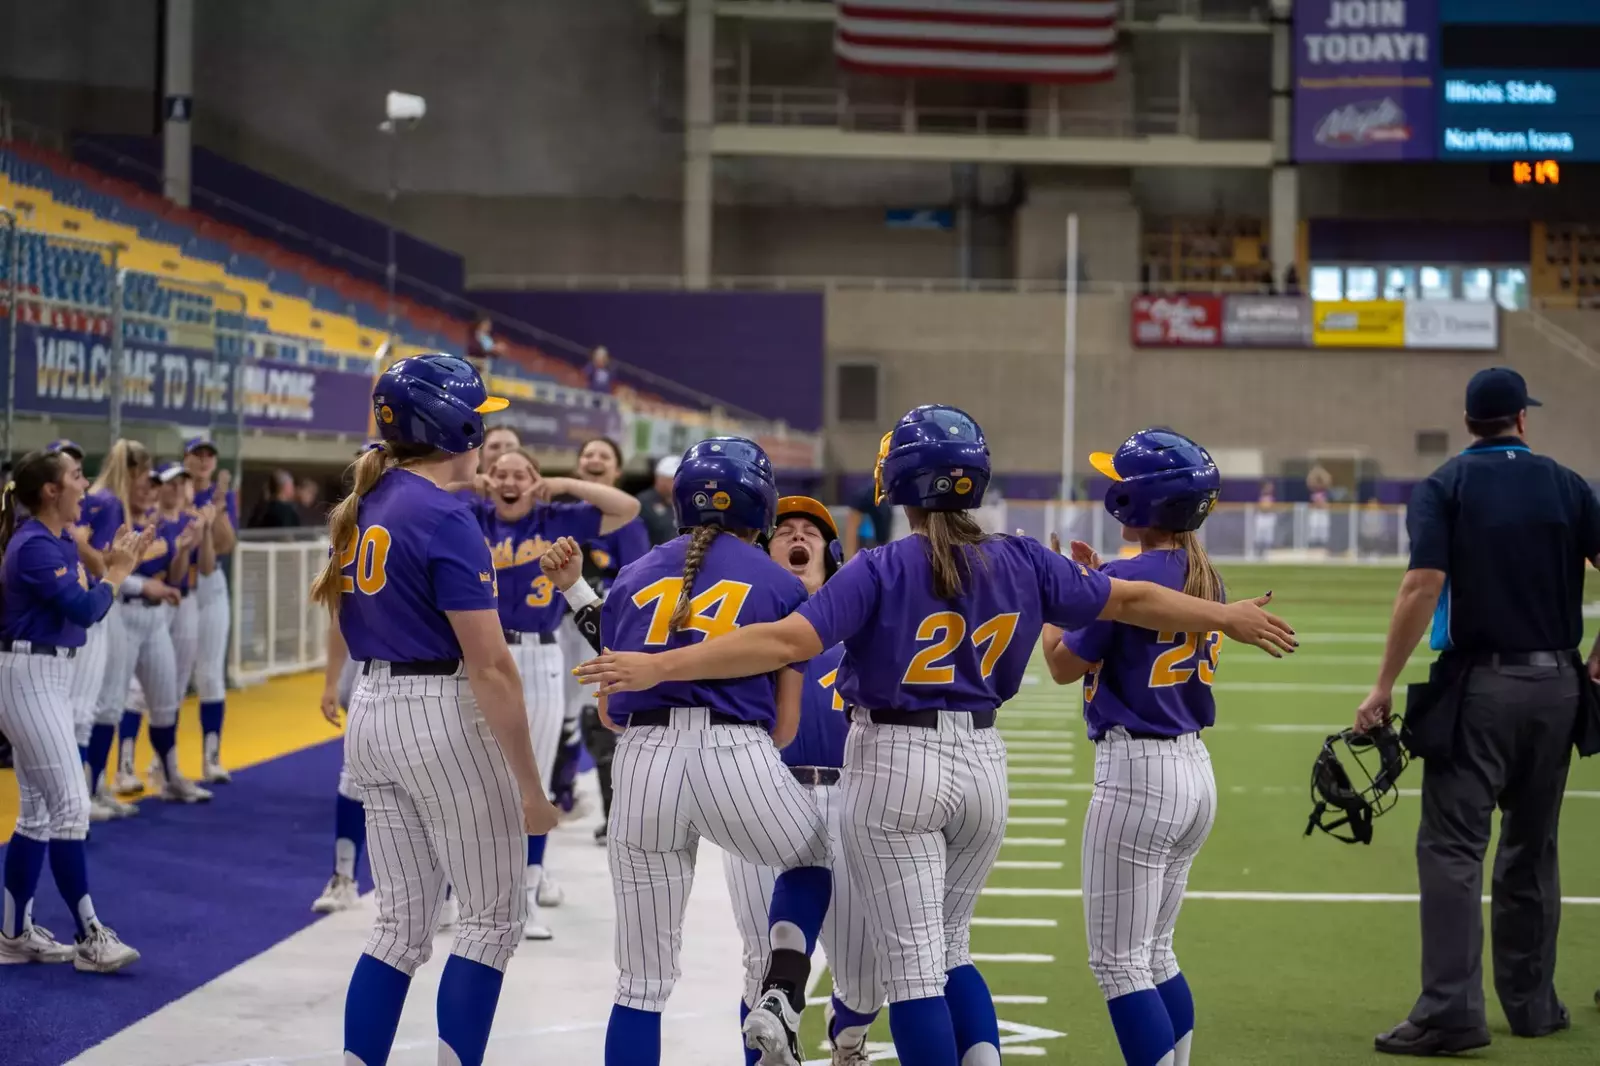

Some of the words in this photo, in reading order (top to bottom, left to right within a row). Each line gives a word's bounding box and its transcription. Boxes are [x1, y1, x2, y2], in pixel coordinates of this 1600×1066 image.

[1326, 0, 1406, 28] JOIN
[1304, 33, 1429, 63] TODAY!
[1445, 80, 1504, 103] Illinois
[1506, 80, 1556, 104] State
[1445, 128, 1526, 151] Northern
[1528, 128, 1574, 151] Iowa
[36, 336, 156, 408] WELCME
[162, 353, 188, 412] TO
[193, 358, 231, 414] THE
[338, 524, 392, 596] 20
[526, 575, 554, 607] 3
[631, 576, 752, 646] 14
[901, 610, 1021, 684] 21
[1147, 630, 1224, 688] 23
